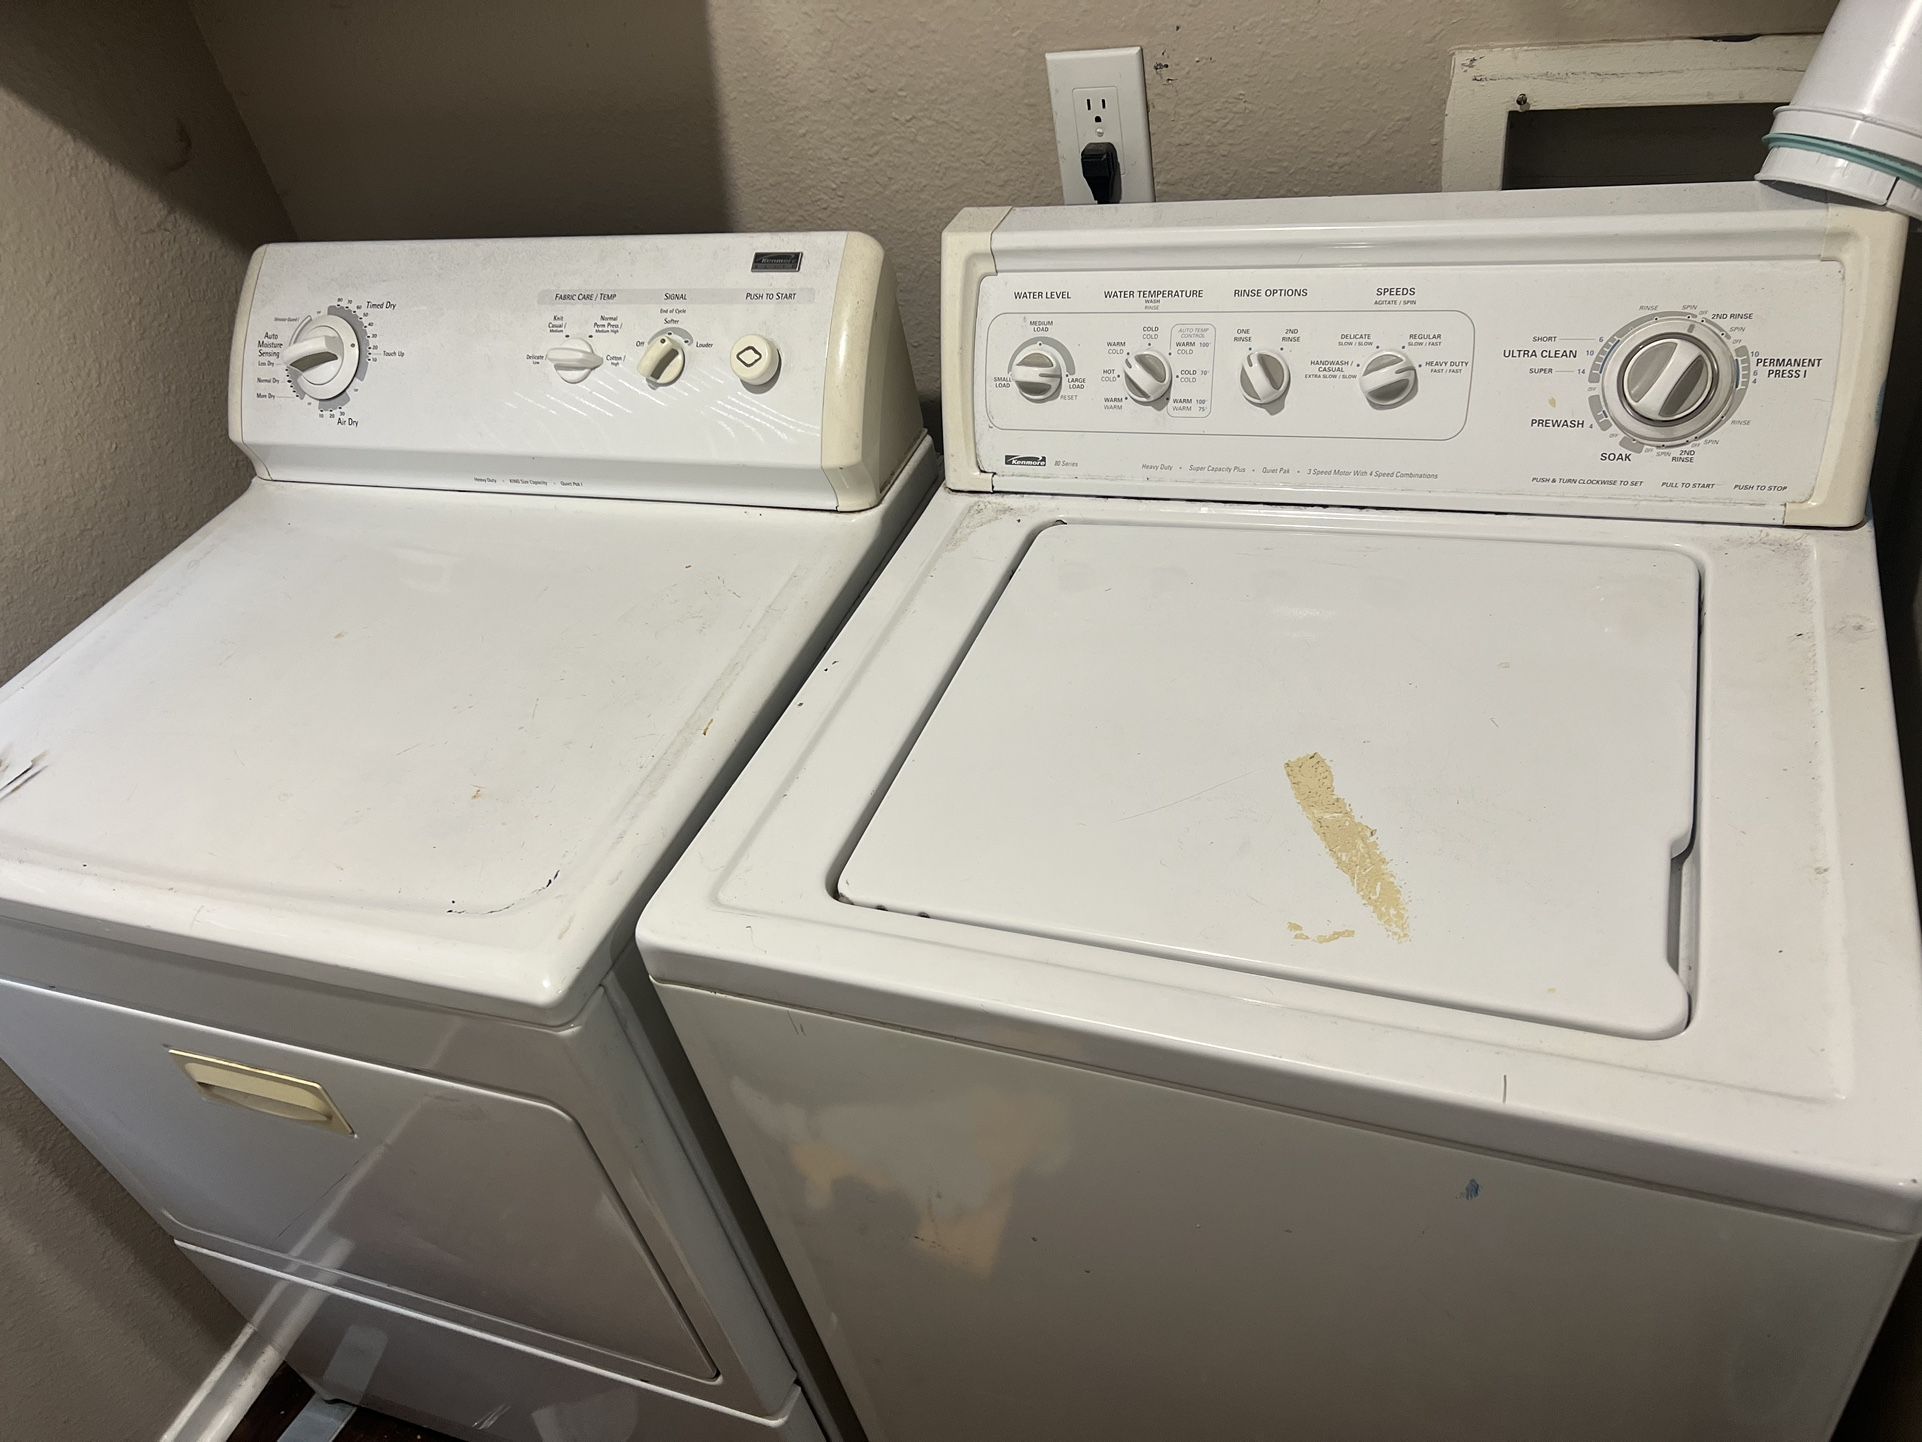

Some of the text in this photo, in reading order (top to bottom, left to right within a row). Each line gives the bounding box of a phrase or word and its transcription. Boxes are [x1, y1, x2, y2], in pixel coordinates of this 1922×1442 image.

[776, 292, 796, 300] START
[1104, 290, 1204, 299] WATER TEMPERATURE
[1234, 289, 1308, 297] RINSE OPTIONS
[1376, 288, 1416, 296] SPEEDS
[386, 301, 396, 310] Dry
[264, 332, 278, 340] Auto
[258, 349, 280, 358] Sensing
[1503, 350, 1537, 358] ULTRA
[1540, 350, 1577, 358] CLEAN
[1756, 358, 1822, 367] PERMANENT
[1767, 370, 1801, 378] PRESS
[348, 418, 358, 428] Dry
[1530, 419, 1585, 428] PREWASH
[1600, 453, 1632, 462] SOAK
[1207, 465, 1232, 473] Capacity
